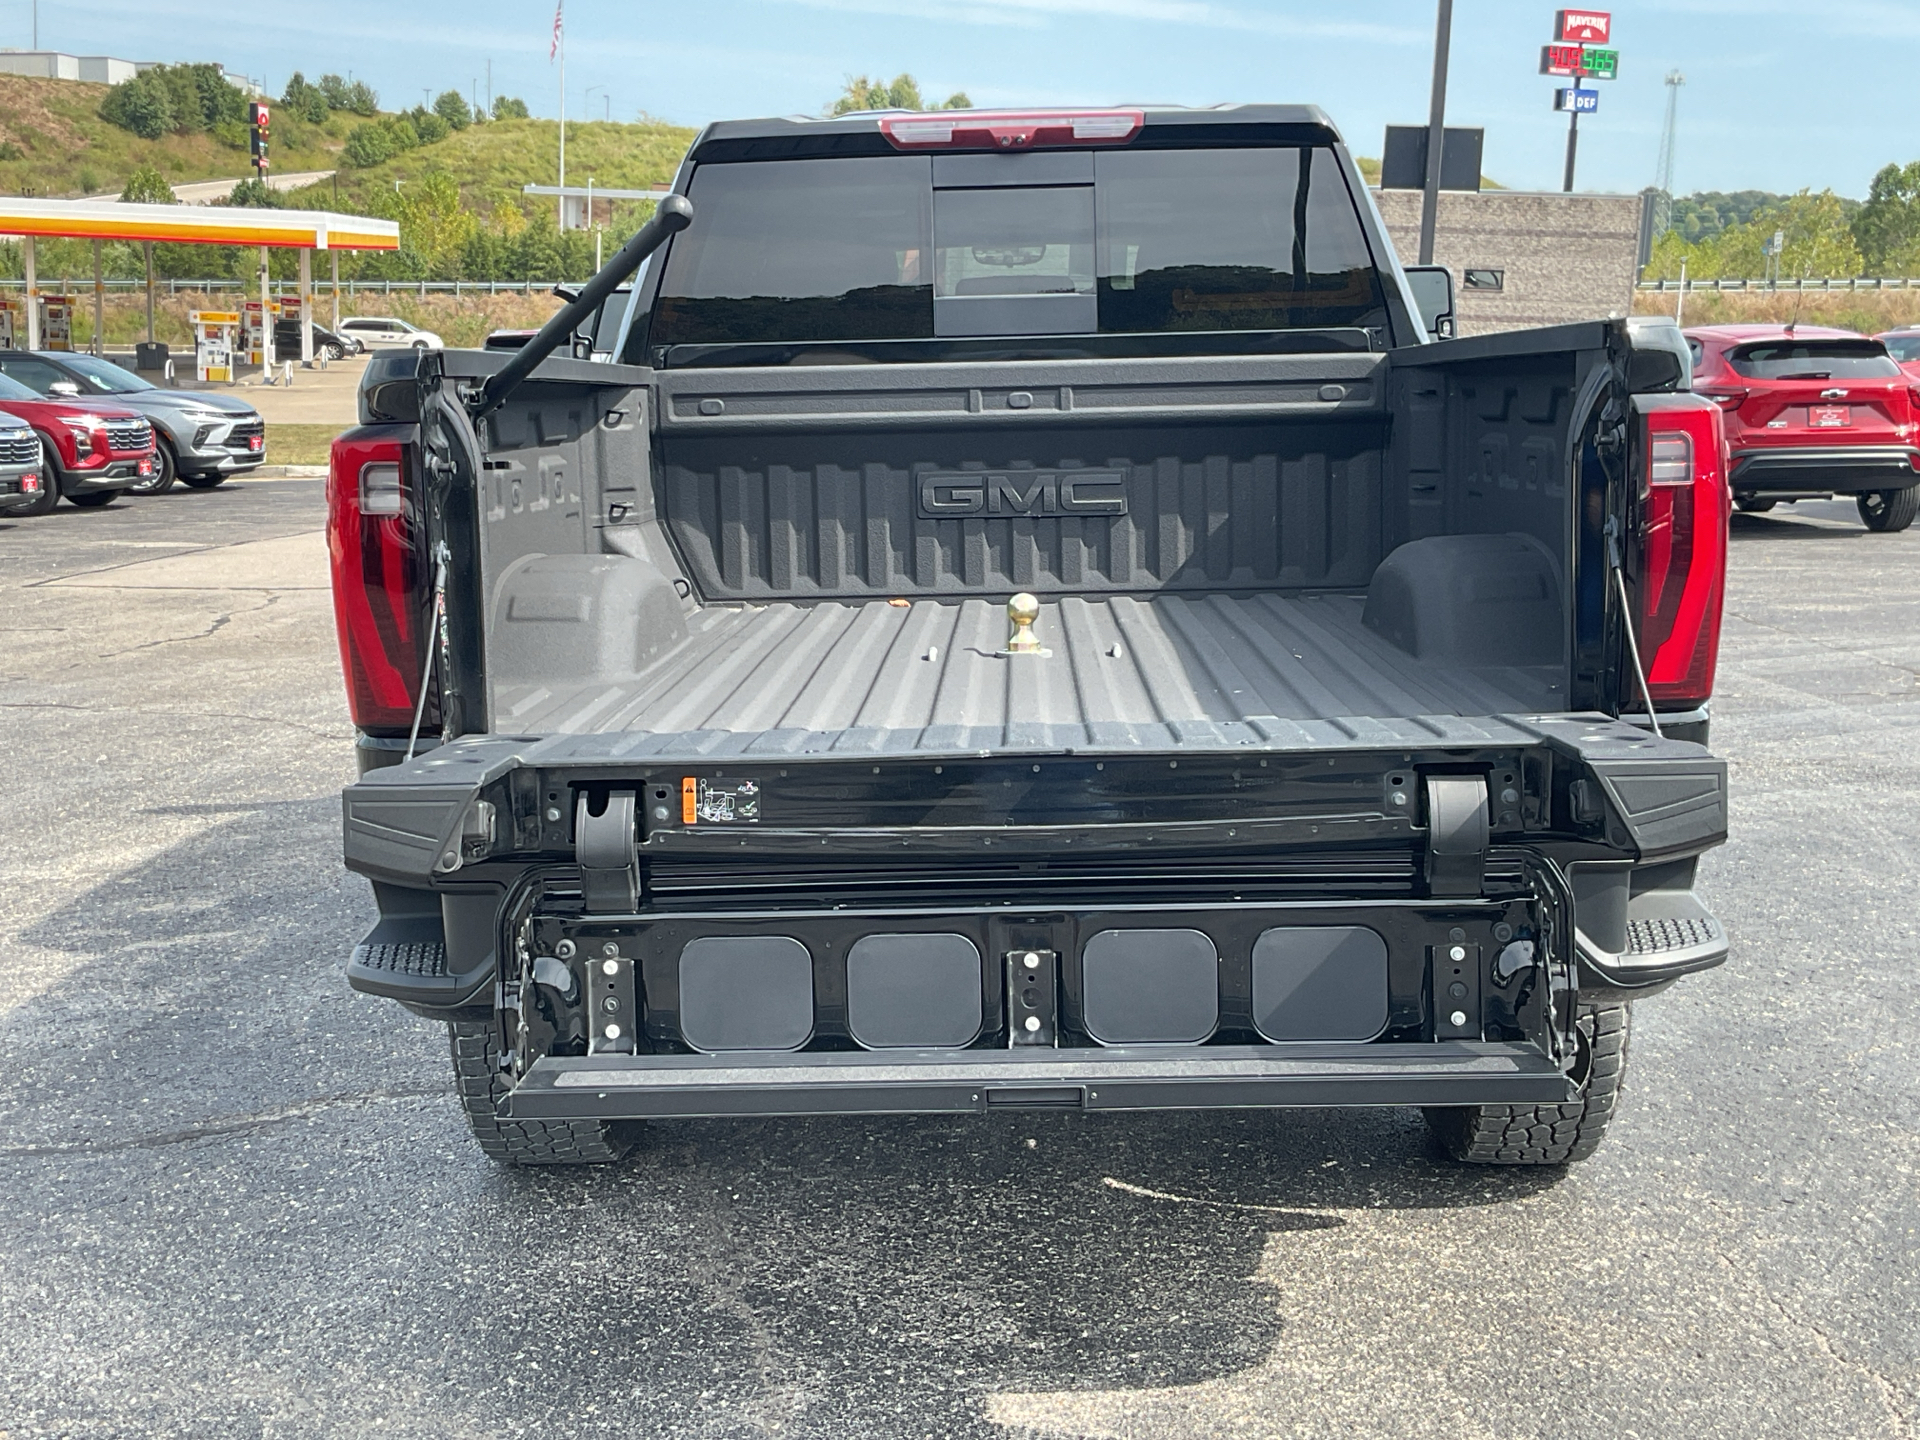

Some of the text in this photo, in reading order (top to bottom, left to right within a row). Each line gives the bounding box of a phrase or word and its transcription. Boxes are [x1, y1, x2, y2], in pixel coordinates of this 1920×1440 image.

[1567, 15, 1607, 35] MAVERIK
[1576, 97, 1596, 108] DEF
[922, 474, 1128, 514] GMC
